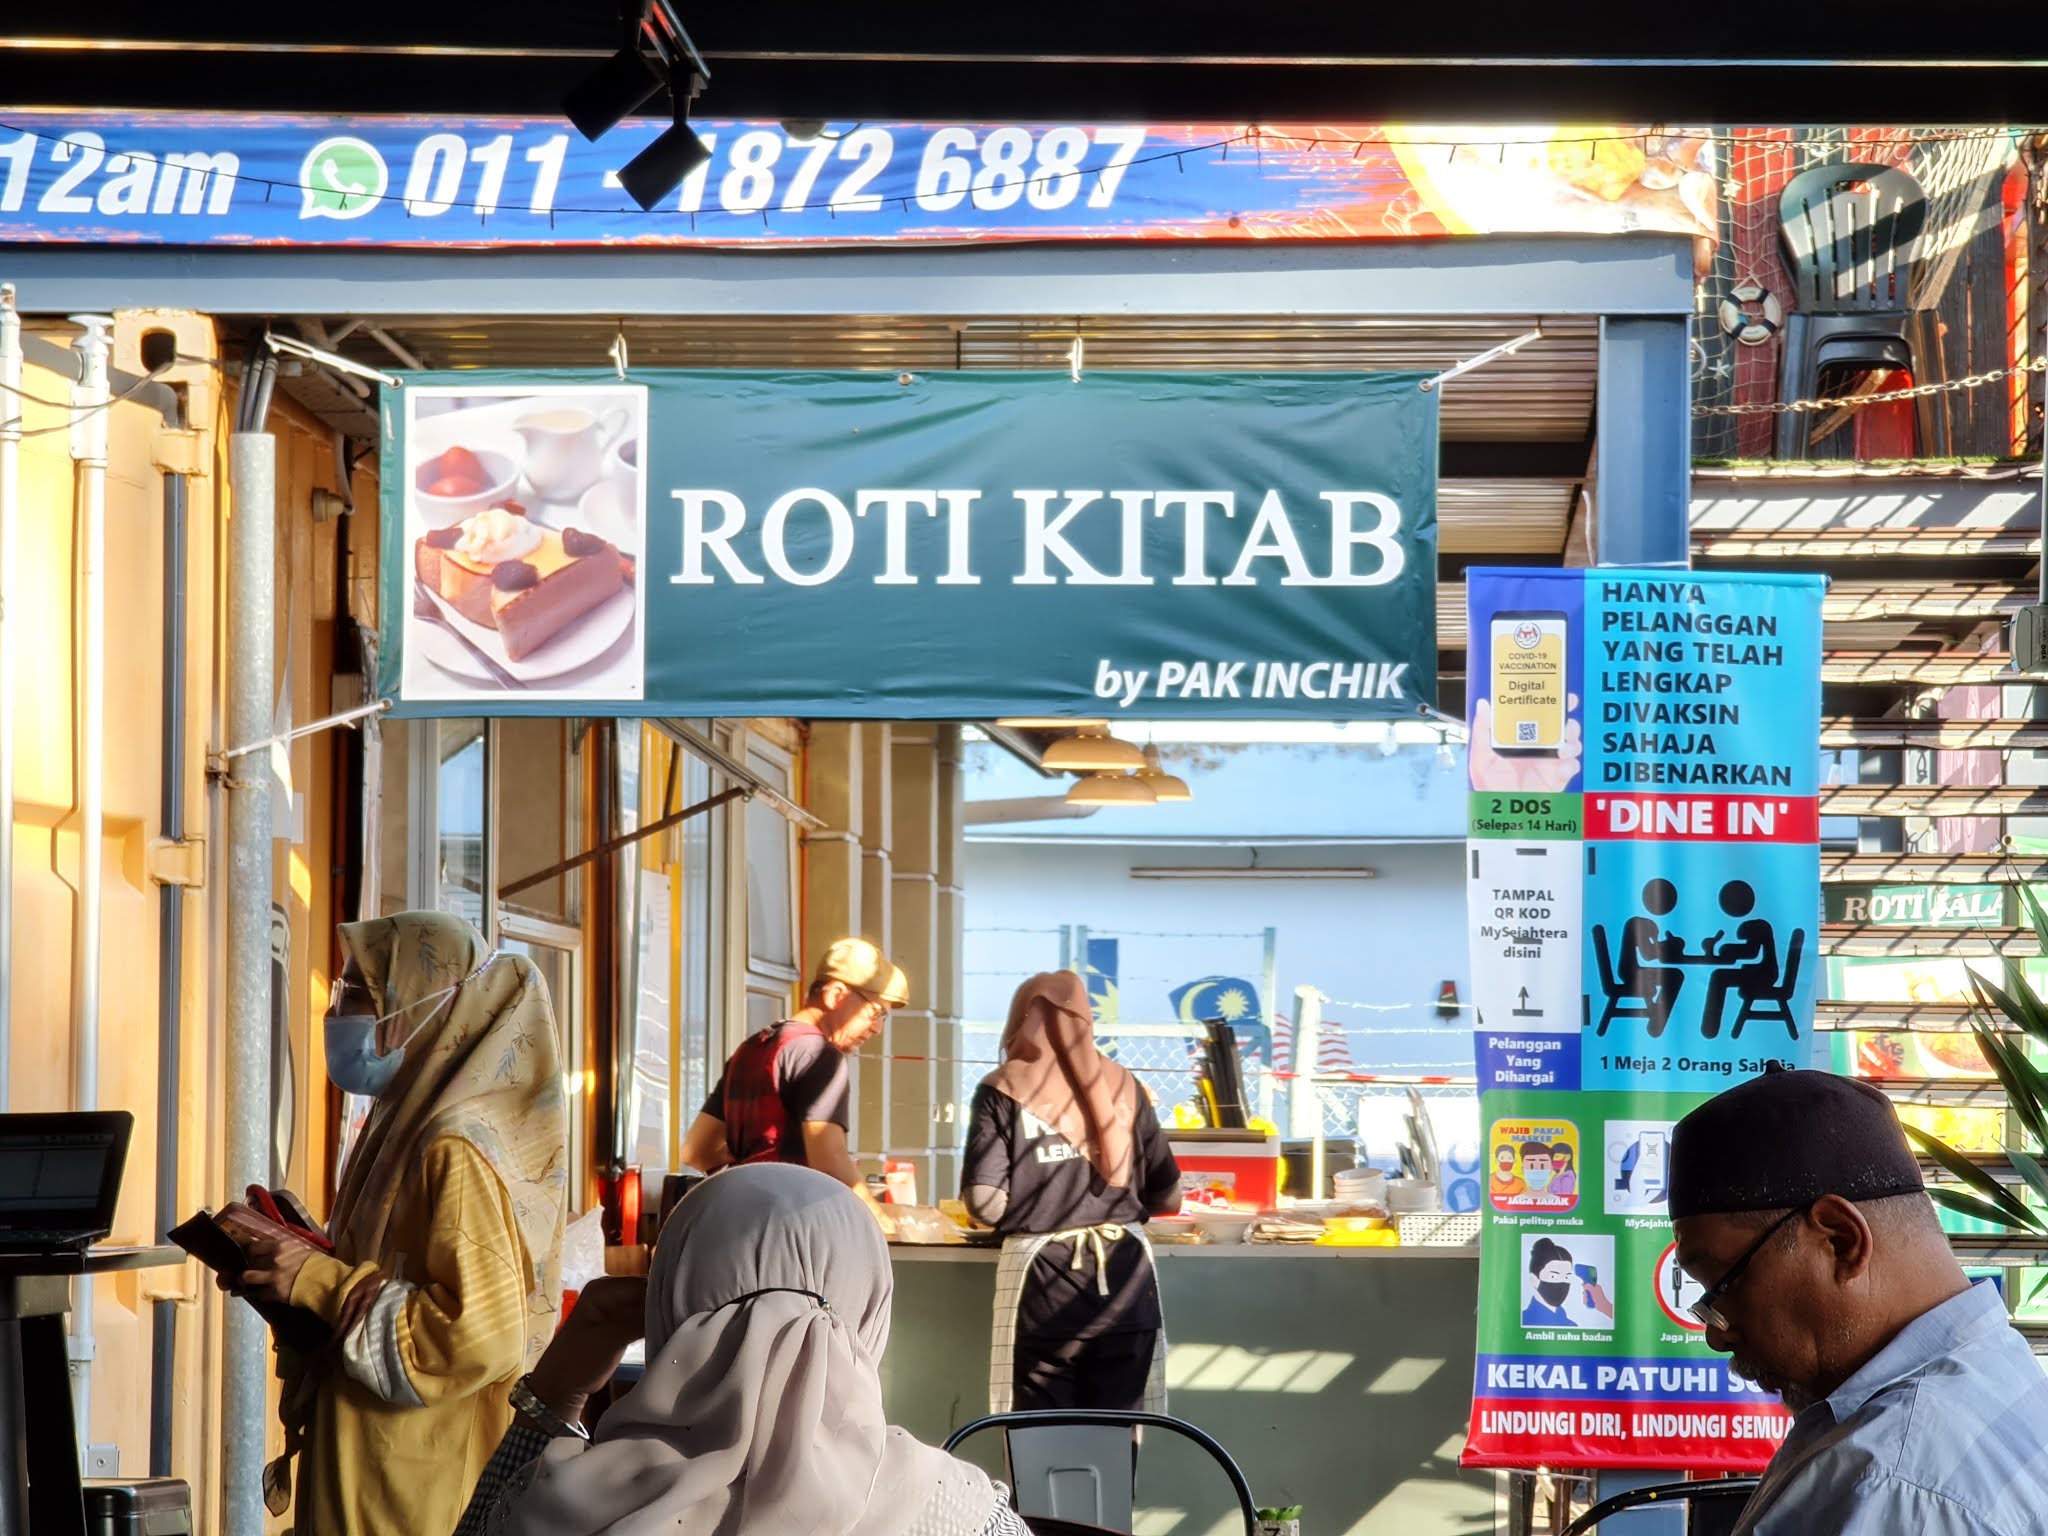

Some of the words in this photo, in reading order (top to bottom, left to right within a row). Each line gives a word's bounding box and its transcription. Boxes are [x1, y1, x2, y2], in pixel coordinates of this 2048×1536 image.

[0, 131, 240, 215] 12am
[404, 134, 568, 216] 011
[677, 127, 894, 215] 1872
[915, 127, 1147, 213] 6887
[670, 488, 982, 586] ROTI
[1012, 490, 1406, 586] KITAB
[1602, 582, 1706, 605] HANYA
[1602, 611, 1777, 636] PELANGGAN
[1602, 641, 1683, 663] YANG
[1693, 642, 1783, 666] TELAH
[1499, 662, 1557, 670] VACCINATION
[1094, 660, 1144, 708] by
[1156, 661, 1241, 698] PAK
[1251, 661, 1408, 700] INCHIK
[1508, 681, 1545, 693] Digital
[1602, 672, 1732, 694] LENGKAP
[1498, 695, 1557, 705] Certificate
[1602, 703, 1739, 725] DIVAKSIN
[1602, 733, 1716, 755] SAHAJA
[1602, 762, 1792, 787] DIBENARKAN
[1491, 799, 1502, 814] 2
[1509, 799, 1552, 815] DOS
[1471, 818, 1523, 833] (Selepas
[1527, 820, 1541, 831] 14
[1545, 820, 1577, 833] Hari)
[1492, 889, 1555, 901] TAMPAL
[1494, 907, 1514, 919] QR
[1519, 908, 1551, 919] KOD
[1843, 894, 1925, 922] ROTI
[1480, 926, 1568, 941] MySejahtera
[1503, 946, 1541, 958] disini
[1489, 1037, 1562, 1053] Pelanggan
[1506, 1055, 1542, 1070] Yang
[1600, 1056, 1608, 1069] 1
[1615, 1056, 1656, 1073] Meja
[1661, 1057, 1671, 1070] 2
[1678, 1058, 1732, 1075] Orang
[1738, 1058, 1796, 1072] Sahja
[1495, 1070, 1555, 1086] Dihargai
[1500, 1127, 1530, 1135] WAJIB
[1493, 1216, 1518, 1225] Pakai
[1519, 1216, 1555, 1227] pelitup
[1556, 1217, 1584, 1226] muka
[1525, 1331, 1555, 1341] Ambil
[1556, 1332, 1580, 1341] suhu
[1582, 1332, 1613, 1342] badan
[1660, 1332, 1683, 1344] Jaga
[1488, 1364, 1588, 1390] KEKAL
[1597, 1366, 1717, 1392] PATUHI
[1481, 1410, 1576, 1436] LINDUNGI
[1581, 1412, 1627, 1441] DIRI,
[1632, 1413, 1727, 1439] LINDUNGI
